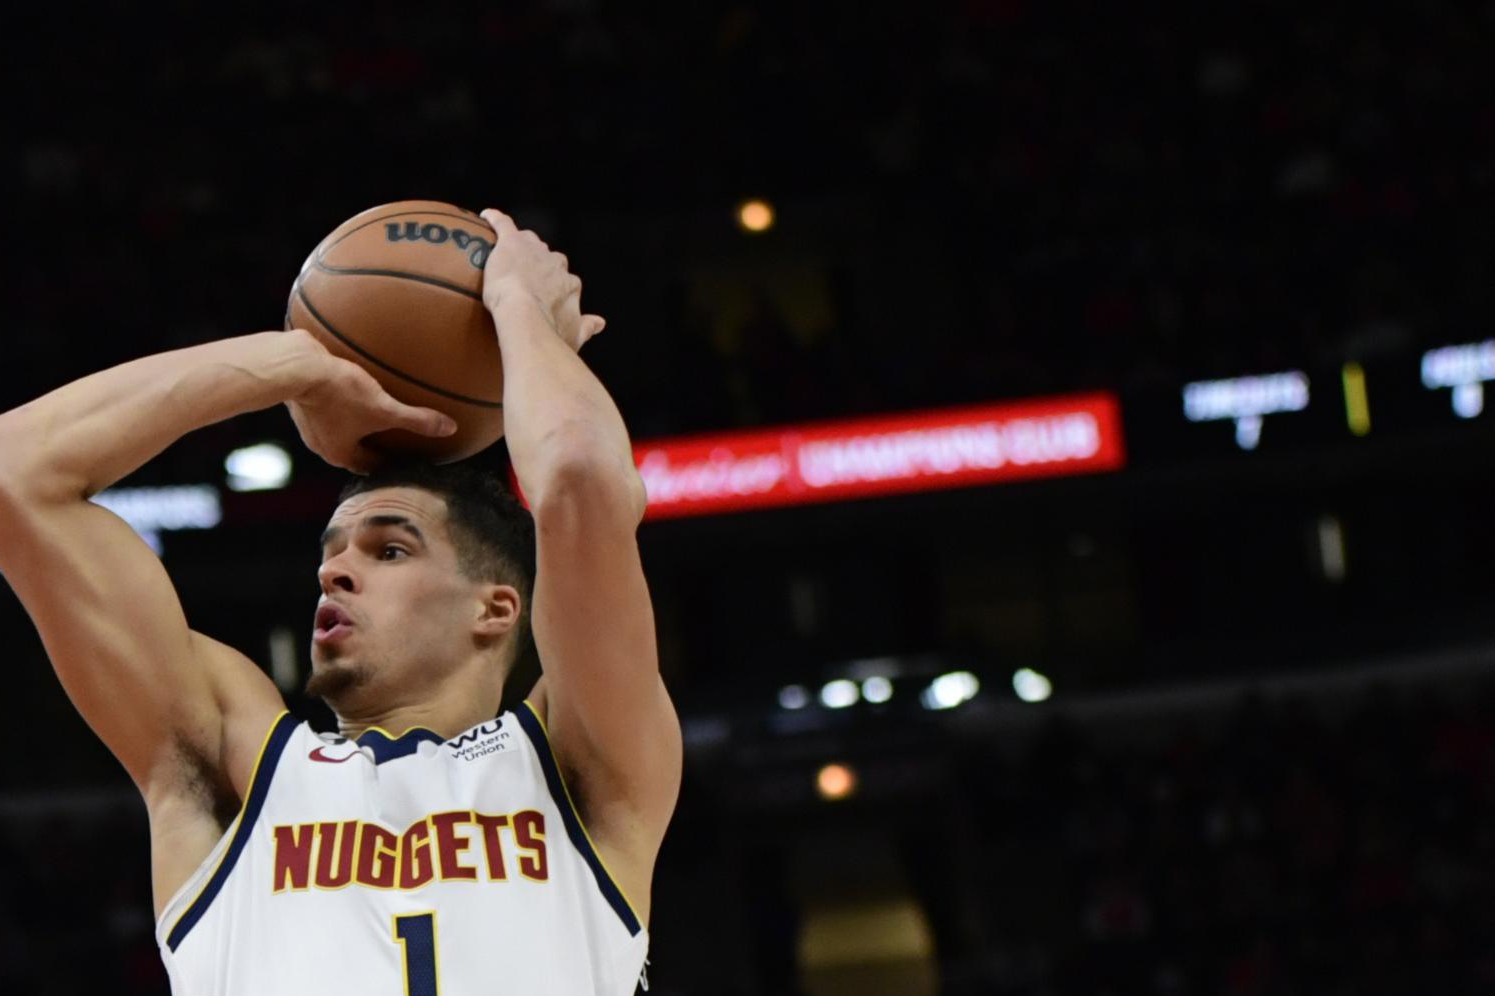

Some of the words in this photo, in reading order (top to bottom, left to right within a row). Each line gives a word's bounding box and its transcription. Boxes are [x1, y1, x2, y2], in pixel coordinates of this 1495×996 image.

[446, 718, 503, 749] WU
[451, 731, 510, 759] Western
[465, 743, 505, 761] Union
[272, 810, 549, 895] NUGGETS
